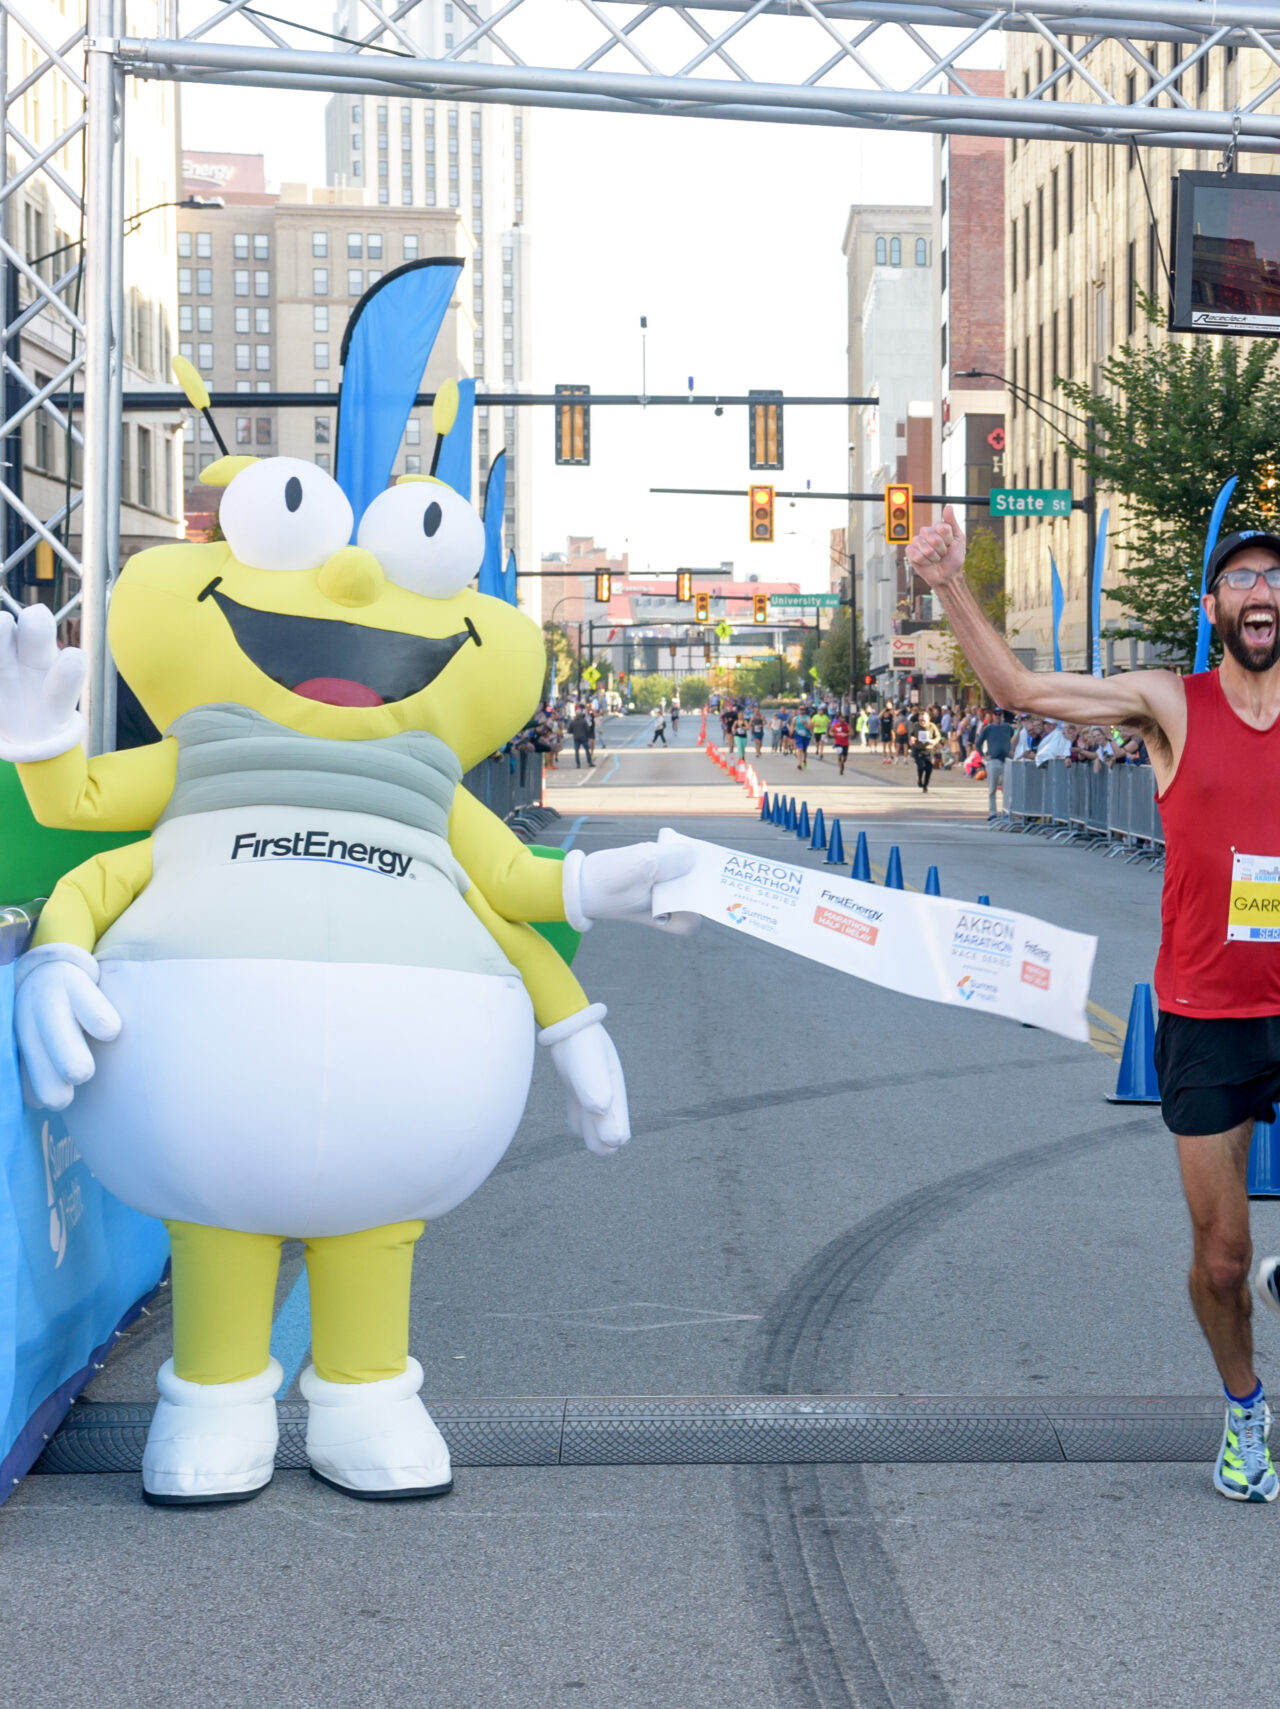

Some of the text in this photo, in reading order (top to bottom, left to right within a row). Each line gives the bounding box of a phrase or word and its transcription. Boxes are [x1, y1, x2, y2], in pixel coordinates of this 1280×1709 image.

[996, 495, 1066, 510] State St
[771, 596, 822, 607] University
[231, 831, 413, 878] FirstEnergy
[723, 865, 801, 896] MARATHON
[725, 855, 804, 886] AKRON
[1254, 873, 1277, 882] AKRON
[720, 878, 798, 908] RACE SERIES
[820, 889, 884, 921] FirstEnergy
[742, 906, 778, 926] Summa
[823, 910, 871, 934] MARATHON
[956, 914, 1016, 941] AKRON
[953, 931, 1013, 953] MARATHON
[951, 948, 977, 961] RACE
